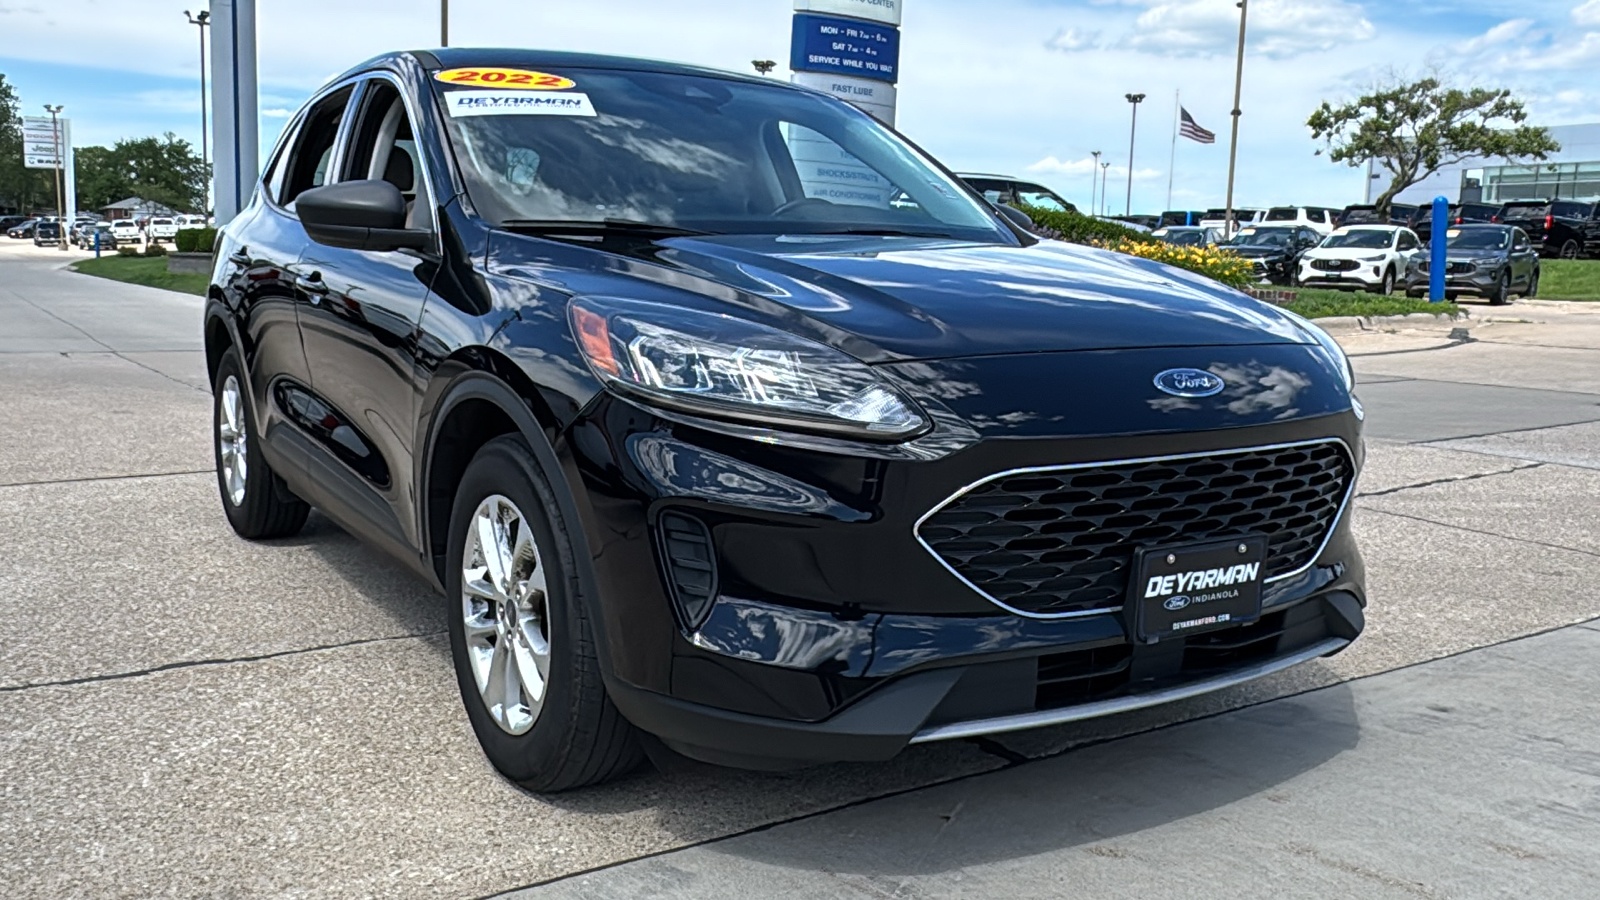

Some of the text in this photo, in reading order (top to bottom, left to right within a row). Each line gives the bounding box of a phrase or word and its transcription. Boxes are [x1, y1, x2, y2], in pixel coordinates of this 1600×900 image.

[820, 26, 838, 34] MON
[846, 29, 858, 38] FRI
[832, 42, 845, 50] SAT
[808, 55, 893, 73] SERVICE WHILE YOU WAIT
[450, 71, 562, 87] 2022
[832, 84, 873, 96] FAST LUBE
[457, 97, 582, 106] DEYARMAN
[1144, 562, 1260, 598] DEYARMAN
[1191, 589, 1240, 604] INDIANOLA
